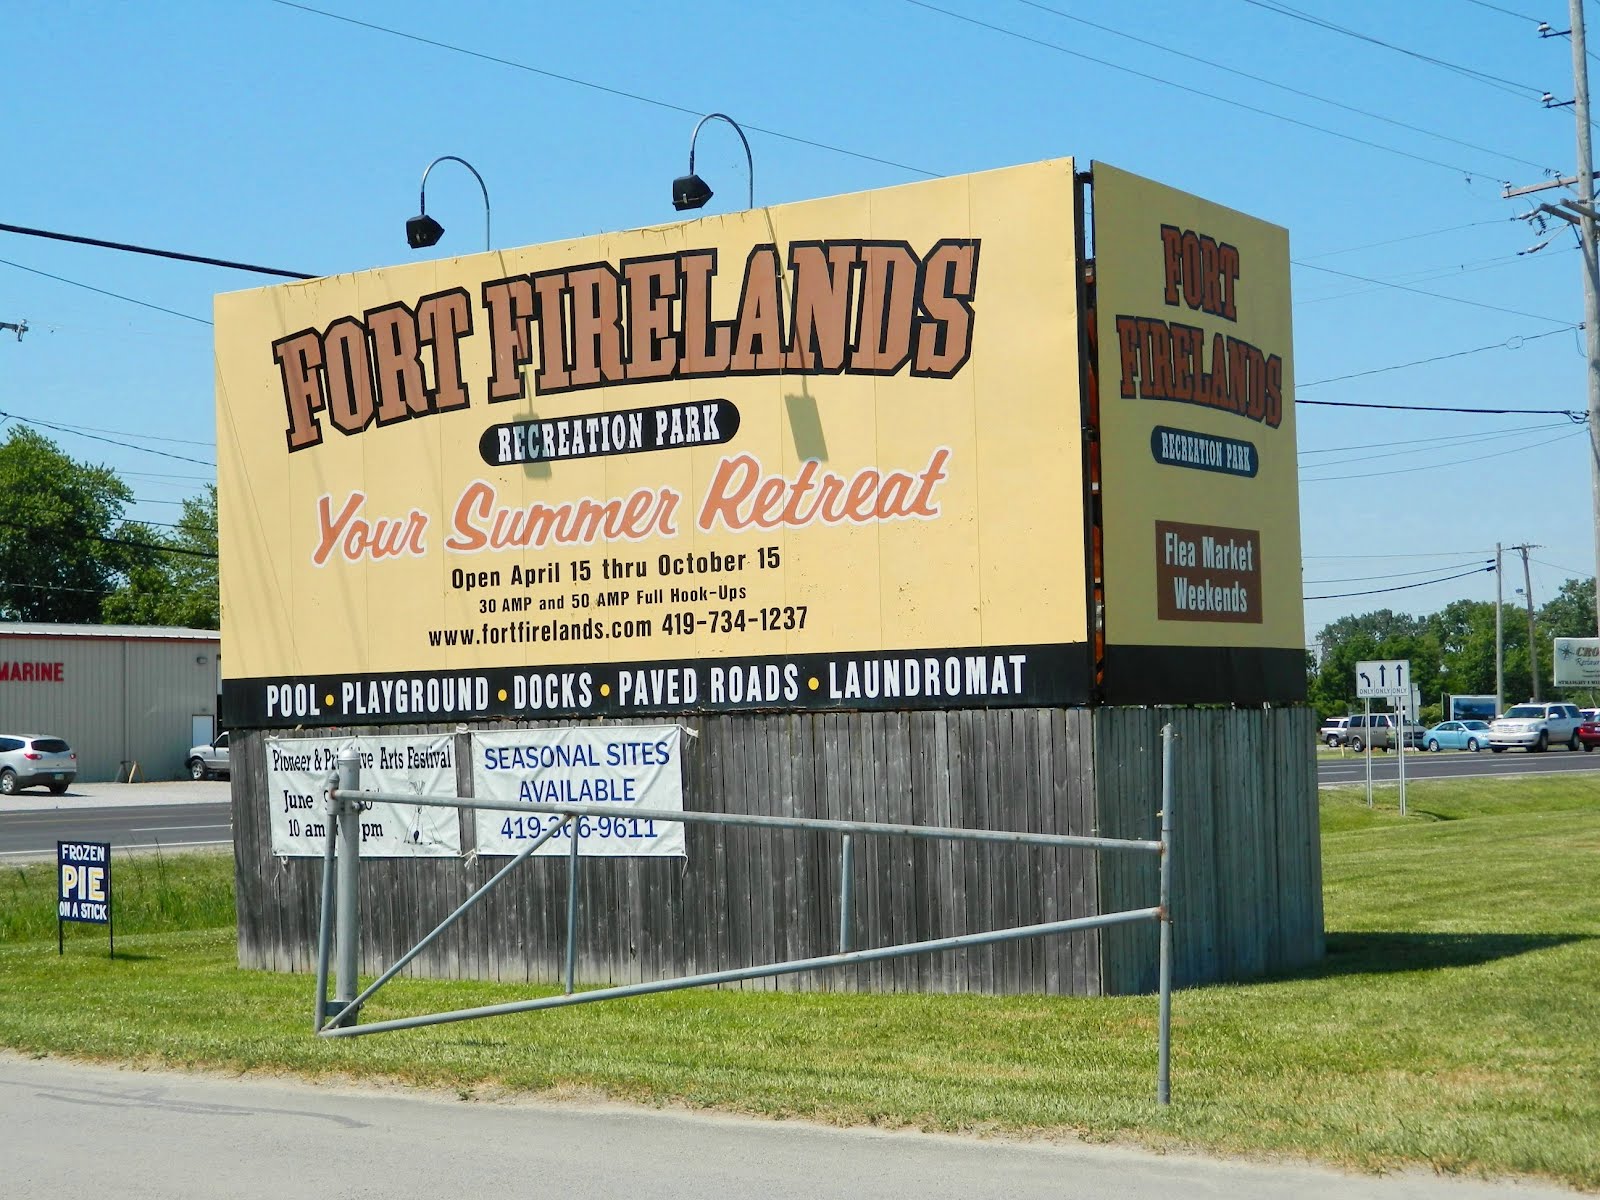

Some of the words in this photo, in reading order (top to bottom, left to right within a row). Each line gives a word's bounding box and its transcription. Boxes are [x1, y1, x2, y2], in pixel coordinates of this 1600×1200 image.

[1160, 223, 1240, 323] FORT
[272, 286, 474, 453] FORT
[481, 238, 981, 404] FIRELANDS
[1116, 314, 1282, 430] FIRELANDS
[498, 414, 644, 463] RECREATION
[655, 403, 720, 444] PARK
[1161, 432, 1222, 467] RECREATION
[1226, 443, 1251, 472] PARK
[310, 489, 429, 570] Your
[445, 478, 682, 553] Summer
[697, 444, 953, 535] Retreat
[451, 565, 501, 592] Open
[510, 562, 560, 588] April
[570, 560, 592, 582] 15
[602, 557, 648, 580] thru
[658, 552, 747, 576] October
[757, 546, 781, 569] 15
[1165, 532, 1195, 567] Flea
[1202, 536, 1253, 571] Market
[479, 598, 497, 614] 30
[501, 596, 532, 612] AMP
[539, 594, 565, 610] and
[571, 592, 590, 609] 50
[597, 591, 630, 608] AMP
[636, 588, 664, 605] Full
[670, 584, 747, 603] Hook-Ups
[1174, 577, 1247, 613] Weekends
[429, 616, 653, 647] www.fortfirelands.com
[661, 605, 808, 637] 419-734-1237
[0, 661, 65, 682] MARINE
[266, 682, 320, 718] POOL
[342, 675, 489, 716] PLAYGROUND
[513, 671, 594, 710] DOCKS
[619, 666, 698, 707] PAVED
[710, 662, 800, 704] ROADS
[828, 654, 1027, 700] LAUNDROMAT
[1360, 687, 1374, 695] ONLY
[1375, 687, 1391, 695] ONLY
[272, 749, 311, 771] Pioneer
[314, 748, 323, 771] &
[324, 747, 374, 770] Prive
[380, 747, 404, 770] Arts
[408, 745, 452, 769] Festival
[484, 745, 600, 770] SEASONAL
[606, 741, 671, 767] SITES
[283, 789, 314, 812] June
[519, 778, 636, 802] AVAILABLE
[289, 819, 301, 837] 10
[305, 825, 326, 838] am
[361, 822, 384, 842] pm
[61, 844, 105, 862] FROZEN
[62, 864, 106, 902] PIE
[59, 900, 71, 917] ON
[72, 901, 79, 918] A
[80, 903, 108, 920] STICK
